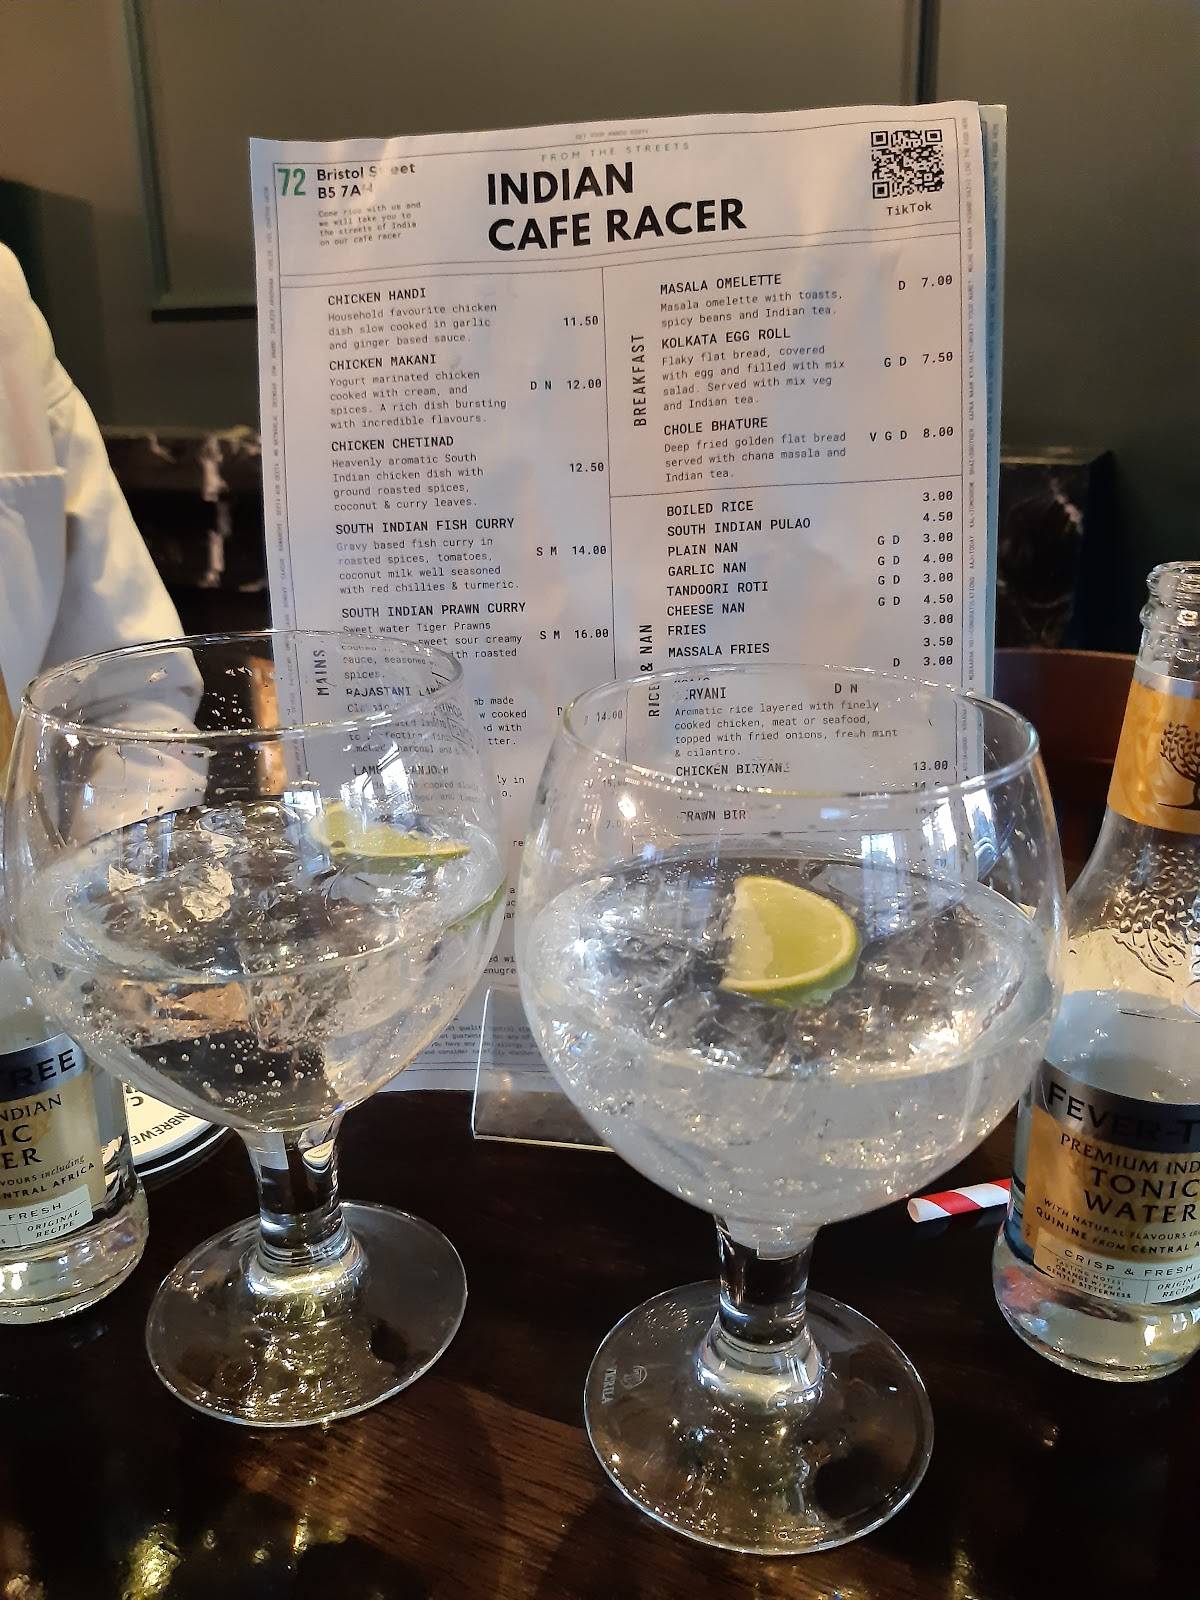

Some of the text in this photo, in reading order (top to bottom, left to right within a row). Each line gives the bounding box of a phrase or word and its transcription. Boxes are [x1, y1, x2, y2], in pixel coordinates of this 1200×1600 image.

[541, 142, 689, 162] FROM THE STREETS
[317, 163, 416, 181] Bristol Seet
[278, 167, 307, 197] 72
[487, 161, 634, 207] INDIAN
[318, 186, 336, 199] B5
[886, 201, 933, 216] TikTok
[488, 198, 747, 251] CAFE RACER
[660, 273, 781, 295] MASALA OMELETTE
[921, 274, 953, 288] 7.00
[327, 287, 426, 306] CHICKEN HANDI
[660, 290, 845, 313] Masala omelette with toasts,
[328, 303, 497, 322] Household favourite chicken
[563, 315, 599, 327] 11.50
[661, 327, 791, 349] KOLKATA EGG ROLL
[329, 353, 436, 371] CHICKEN MAKANI
[883, 356, 907, 368] G D
[922, 351, 953, 364] 7.50
[530, 380, 552, 391] D N
[567, 378, 602, 390] 12.00
[631, 334, 648, 427] BREAKFAST
[663, 416, 768, 436] CHOLE BHATURE
[923, 426, 954, 439] 8.00
[331, 435, 454, 452] CHICKEN CHETINAD
[664, 431, 846, 453] Deep fried golden flat bread
[869, 430, 908, 442] V G D
[332, 452, 477, 468] Heavenly aromatic South
[569, 462, 604, 473] 12.50
[922, 490, 953, 502] 3.00
[666, 500, 754, 517] BOILED RICE
[922, 511, 953, 522] 4.50
[335, 517, 515, 535] SOUTH INDIAN FISH CURRY
[667, 517, 811, 537] SOUTH INDIAN PULAO
[923, 531, 953, 543] 3.00
[571, 545, 607, 555] 14.00
[667, 541, 738, 557] PLAIN NAN
[922, 552, 953, 564] 4.00
[668, 561, 747, 577] GARLIC NAN
[923, 572, 954, 583] 3.00
[339, 581, 521, 595] with red chillies & turmeric.
[666, 581, 768, 597] TANDOORI ROTI
[923, 593, 954, 604] 4.50
[341, 601, 526, 619] SOUTH INDIAN PRAWN CURRY
[666, 602, 745, 617] CHEESE NAN
[923, 613, 954, 625] 3.00
[574, 628, 609, 639] 16.00
[667, 623, 706, 636] FRIES
[455, 635, 480, 646] sour
[486, 634, 523, 646] creamy
[639, 624, 653, 655] NAN
[923, 636, 954, 647] 3.50
[475, 647, 518, 659] roasted
[668, 642, 770, 658] MASSALA FRIES
[923, 655, 953, 666] 3.00
[312, 649, 330, 697] MAINS
[490, 697, 515, 705] made
[674, 699, 879, 717] Aromatic rice layered with finely
[491, 709, 528, 719] cooked
[498, 722, 523, 732] with
[675, 764, 729, 777] CHICKEN
[914, 760, 949, 771] 13.00
[1, 1147, 42, 1170] ER
[1060, 1132, 1159, 1174] PREMIUM
[1, 1162, 95, 1200] NTRAL AFRICA
[1089, 1166, 1200, 1200] TONIC
[8, 1202, 62, 1221] FRESH
[1084, 1189, 1198, 1225] WATER
[27, 1209, 80, 1232] ORIGINAL
[1044, 1197, 1070, 1217] WITH
[1072, 1214, 1128, 1237] NATURAL
[1129, 1231, 1187, 1242] FLAVOURS
[35, 1221, 74, 1239] RECIPE
[1036, 1206, 1190, 1255] QUININE FROM CENTRAL
[1064, 1249, 1194, 1277] CRISP & FRESH
[1078, 1281, 1132, 1300] BITTERNESS
[1162, 1284, 1195, 1299] RECIPE
